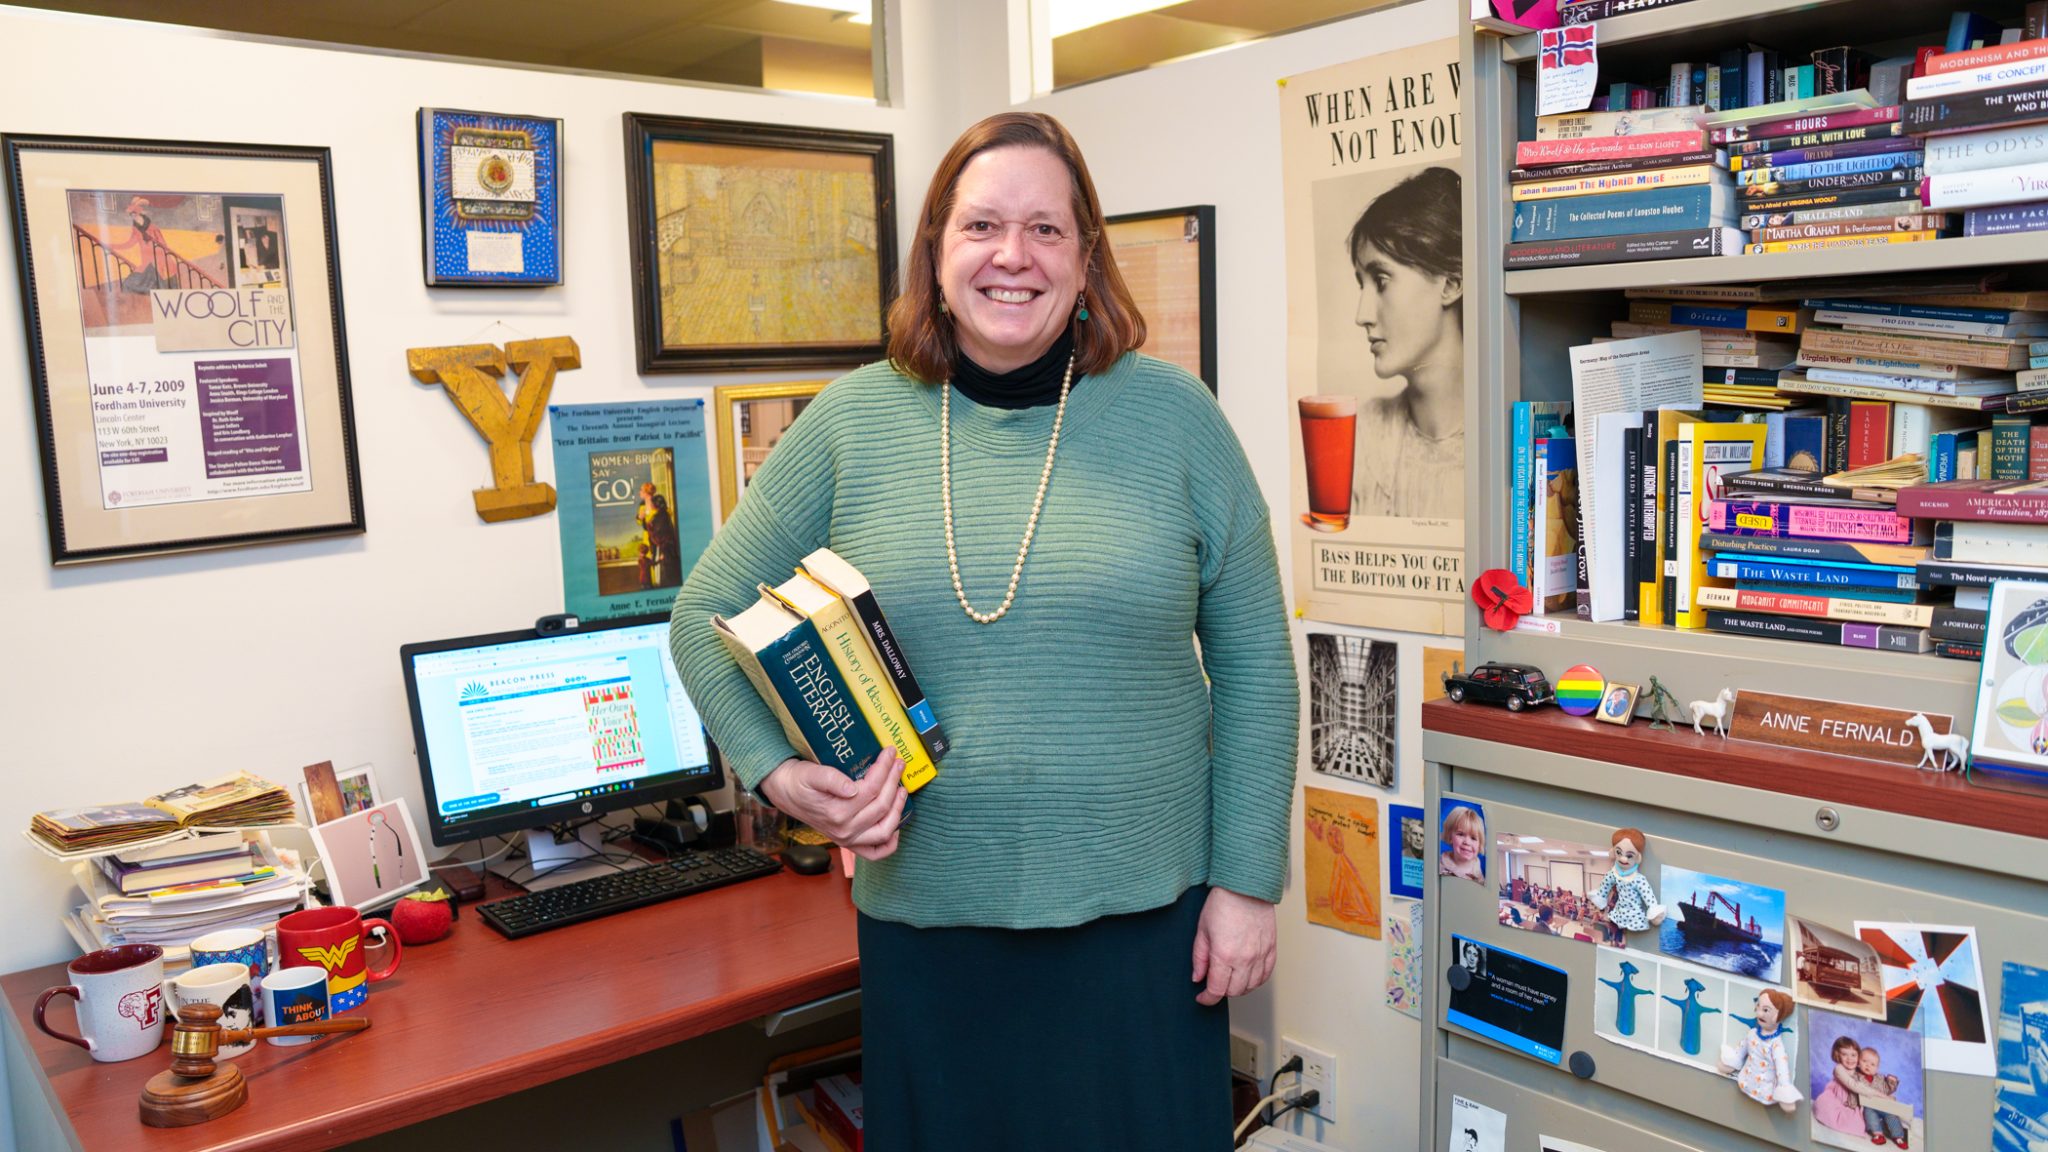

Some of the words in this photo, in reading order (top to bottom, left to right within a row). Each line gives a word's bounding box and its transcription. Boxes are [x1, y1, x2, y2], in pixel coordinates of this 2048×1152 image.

[1940, 55, 2002, 70] MODERNISM
[2007, 48, 2029, 59] AND
[2034, 46, 2048, 55] TH
[1997, 64, 2045, 79] CONCEPT
[1306, 86, 1371, 127] WHEN
[1385, 73, 1434, 112] ARE
[1448, 62, 1460, 100] W
[1985, 97, 2003, 105] THE
[2007, 92, 2048, 103] TWENTI
[1795, 117, 1828, 131] HOURS
[1331, 128, 1377, 166] NOT
[1392, 113, 1461, 155] ENOU
[1791, 137, 1800, 147] TO
[1803, 135, 1820, 146] SIR,
[1822, 132, 1843, 143] WITH
[1846, 128, 1866, 139] LOVE
[1540, 144, 1563, 158] Woolf
[1572, 142, 1585, 154] the
[1586, 142, 1623, 154] Servants
[1628, 142, 1652, 151] ALISON
[1654, 140, 1680, 149] LIGHT
[1933, 143, 1973, 160] THE
[1985, 134, 2044, 154] ODYS
[1804, 151, 1833, 161] ORLANDO
[1808, 164, 1822, 174] TO
[1825, 162, 1843, 173] THE
[1847, 153, 1913, 171] LIGHTHOUSE
[1808, 176, 1845, 188] UNDER
[1853, 173, 1883, 183] SAND
[1520, 186, 1540, 196] Jahan
[1542, 184, 1577, 194] Ramazani
[1765, 201, 1782, 209] Afraid
[1789, 198, 1813, 207] VIRGINIA
[1814, 196, 1838, 205] WOOLF?
[1569, 211, 1579, 222] The
[1580, 209, 1605, 222] Collected
[1607, 208, 1625, 219] Poems
[1627, 208, 1633, 218] of
[1635, 207, 1660, 218] Langston
[1662, 205, 1684, 216] Hughes
[1798, 212, 1828, 222] SMALL
[1829, 209, 1863, 220] ISLAND
[1767, 228, 1802, 240] MARTHA
[1804, 225, 1840, 237] GRAHAM
[1852, 224, 1891, 233] Performance
[1788, 243, 1809, 251] PARIS
[1827, 239, 1865, 248] LUMINOUS
[1867, 237, 1888, 246] YEARS
[153, 290, 264, 320] WOOLF
[267, 295, 285, 304] AND
[268, 306, 285, 315] THE
[1691, 312, 1727, 322] Orlando
[228, 319, 287, 347] CITY
[1801, 354, 1829, 364] Virginia
[1830, 355, 1852, 364] Woolf
[1866, 359, 1876, 367] the
[1878, 360, 1920, 370] Lighthouse
[93, 383, 123, 396] June
[126, 381, 151, 395] 4-7,
[155, 380, 185, 393] 2009
[95, 401, 137, 411] Fordham
[139, 399, 186, 410] University
[96, 414, 121, 424] Lincoln
[123, 414, 145, 422] Center
[98, 427, 111, 435] 113
[112, 426, 119, 434] W
[139, 425, 160, 433] Street
[406, 336, 581, 523] Y
[99, 440, 113, 448] New
[114, 439, 134, 448] York,
[135, 438, 145, 446] NY
[147, 436, 168, 446] 10023
[592, 456, 630, 467] WOMEN
[635, 453, 672, 465] BRITAIN
[1939, 452, 1948, 482] VIRGINIA
[1644, 465, 1656, 500] ANTIGONE,
[1966, 498, 2019, 507] AMERICAN
[2022, 499, 2048, 508] LITE
[1643, 501, 1656, 541] INTERRUPTED
[1740, 516, 1767, 527] USED
[1711, 539, 1746, 550] Disturbing
[1748, 540, 1777, 551] Practices
[1321, 549, 1350, 564] BASS
[1355, 551, 1397, 568] HELPS
[1401, 554, 1428, 570] YOU
[1433, 556, 1459, 572] GET
[1321, 568, 1346, 583] THE
[1352, 570, 1405, 588] BOTTOM
[1412, 575, 1431, 590] OF
[1436, 575, 1450, 592] IT
[1456, 578, 1464, 593] A
[1742, 567, 1765, 579] THE
[1770, 569, 1810, 581] WASTE
[1816, 569, 1849, 583] LAND
[1706, 593, 1730, 601] BERMAN
[1741, 594, 1776, 607] MODERNIST
[1779, 598, 1824, 612] COMMITMENTS
[836, 631, 863, 673] History
[871, 621, 883, 640] MRS.
[880, 638, 907, 680] DALLOWAY
[489, 676, 527, 687] BEACON
[529, 672, 556, 682] PRESS
[858, 673, 873, 688] of
[805, 653, 855, 733] ENGLISH
[865, 686, 883, 714] Ideas
[591, 703, 608, 716] Her
[608, 702, 629, 715] Own
[789, 662, 855, 764] LITERATURE
[880, 711, 893, 729] on
[1760, 711, 1811, 733] ANNE
[1820, 719, 1914, 748] FERNALD
[889, 720, 914, 765] Woman
[906, 764, 929, 781] Putnam
[1496, 977, 1514, 986] woman
[1540, 991, 1557, 1003] money
[1505, 987, 1518, 995] room
[281, 1002, 314, 1016] THINK
[295, 1006, 327, 1023] ABOUT
